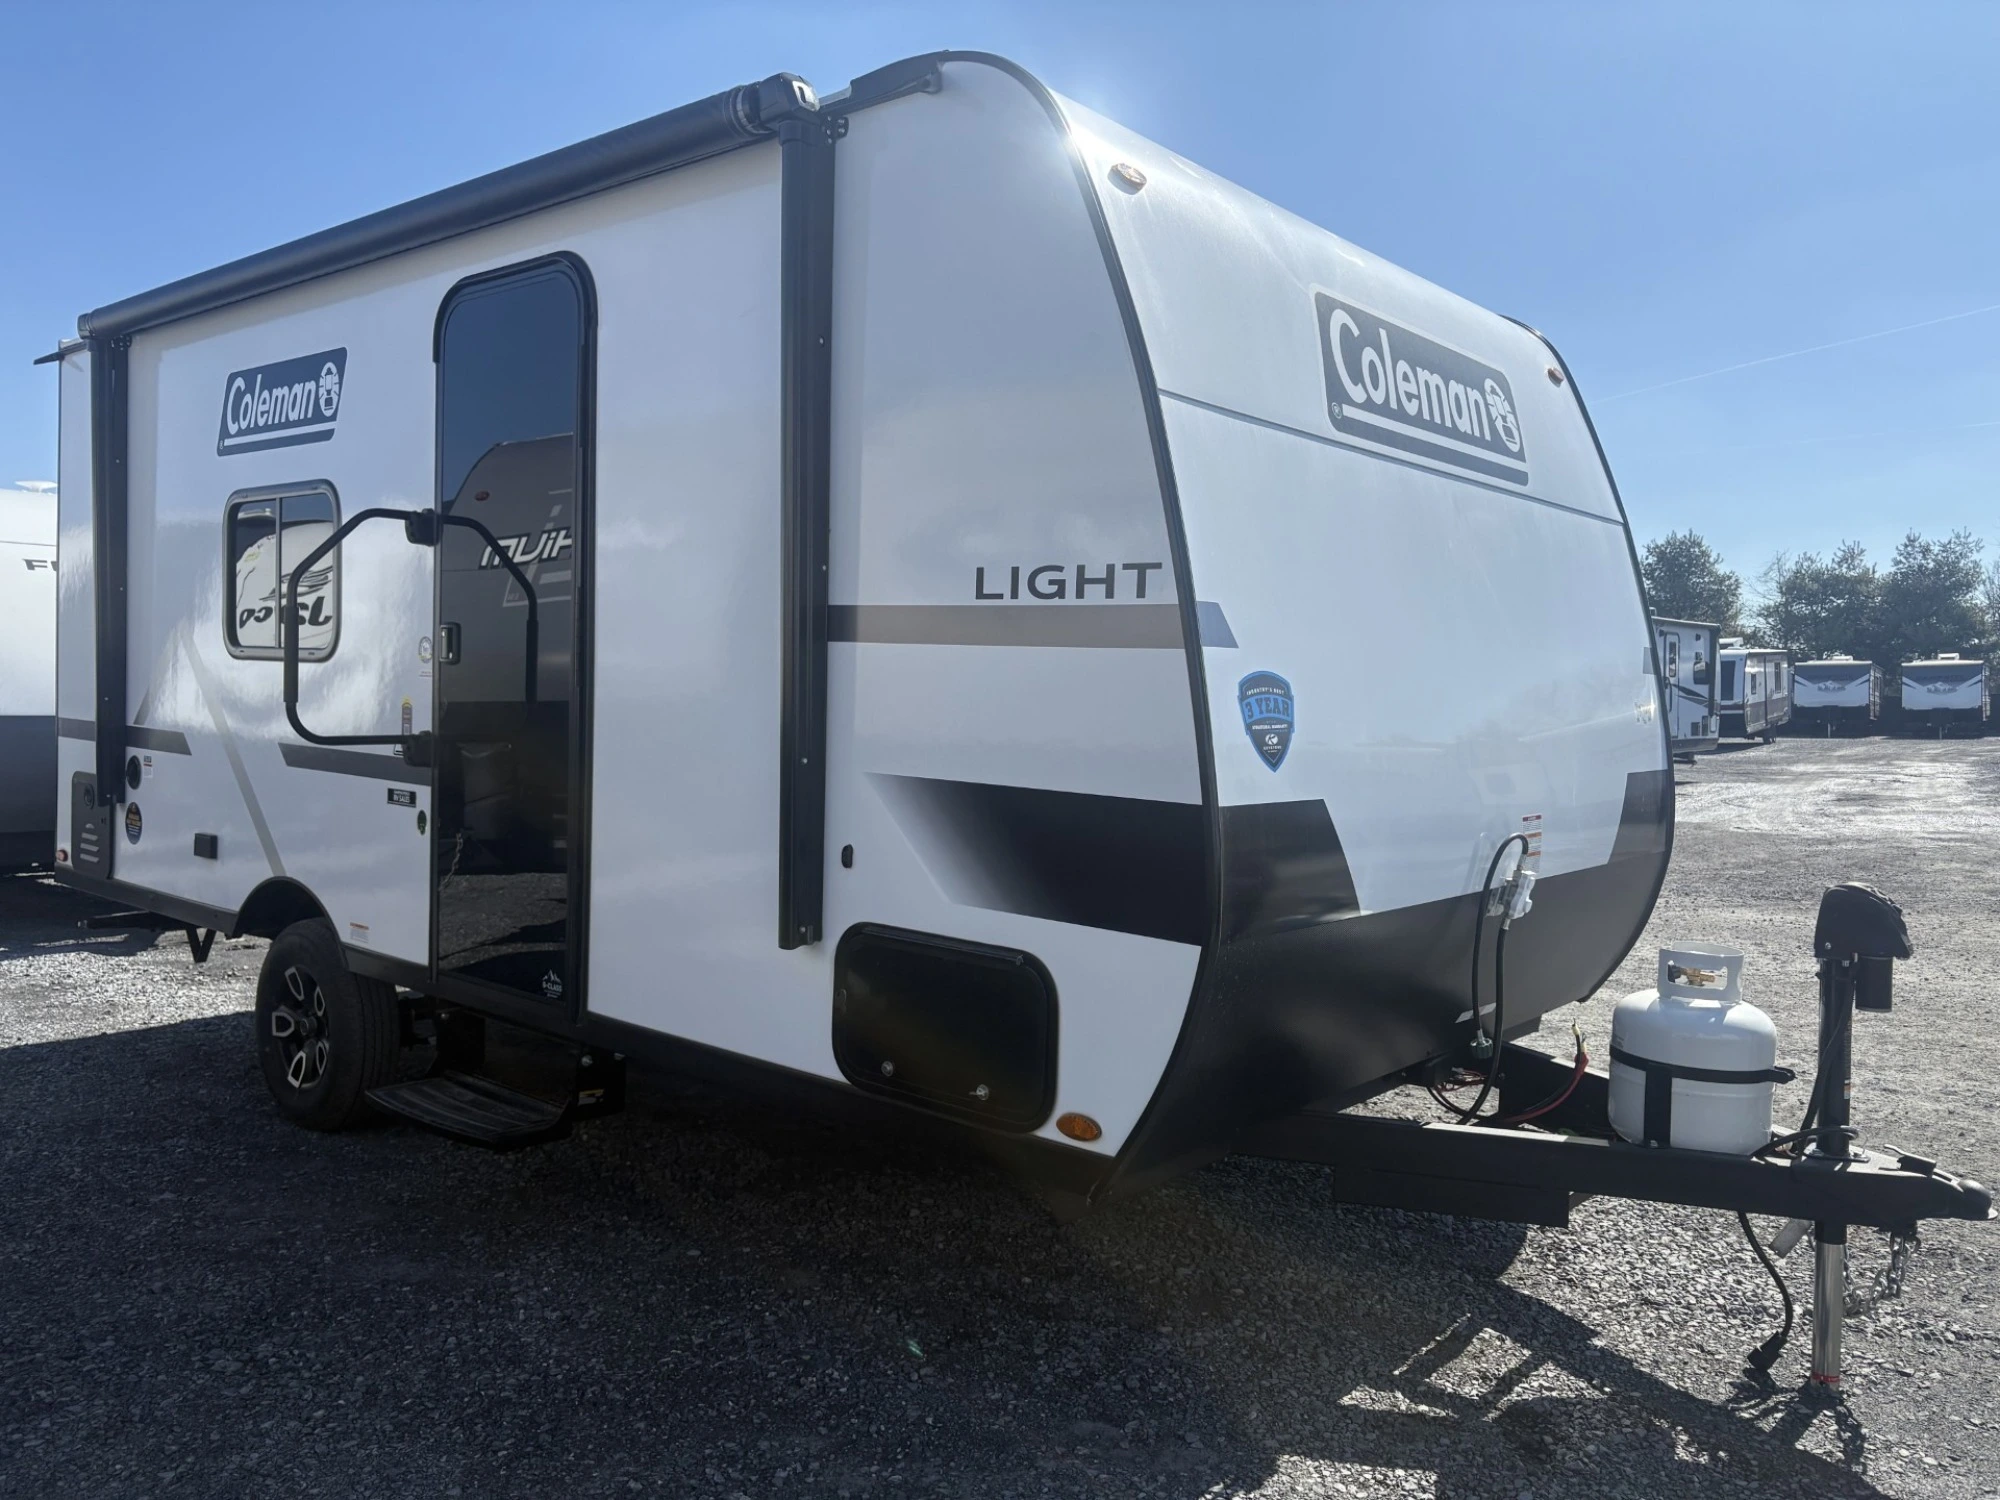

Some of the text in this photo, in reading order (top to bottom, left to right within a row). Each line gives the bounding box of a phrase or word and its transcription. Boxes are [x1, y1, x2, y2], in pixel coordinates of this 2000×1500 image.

[1330, 308, 1492, 442] Coleman
[226, 374, 317, 435] Coleman
[975, 562, 1163, 600] LIGHT
[1255, 697, 1289, 717] YEAR
